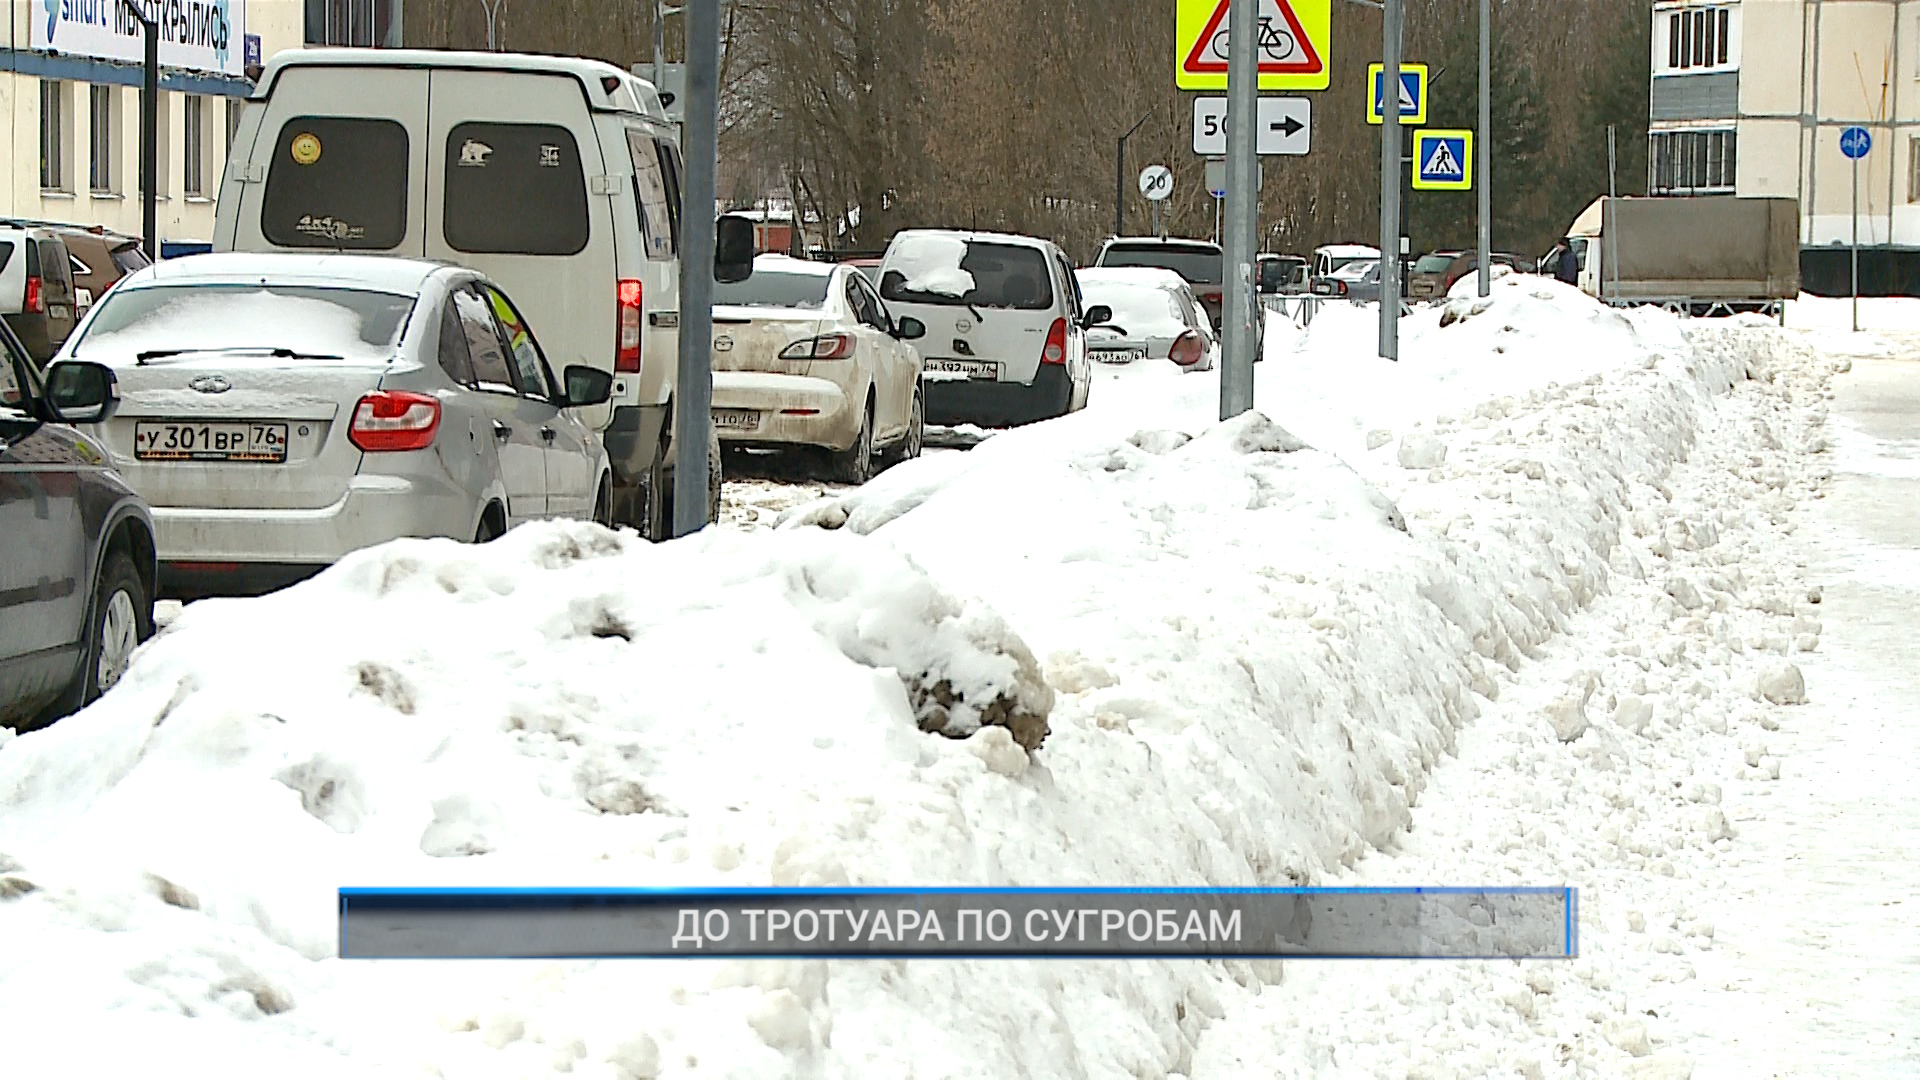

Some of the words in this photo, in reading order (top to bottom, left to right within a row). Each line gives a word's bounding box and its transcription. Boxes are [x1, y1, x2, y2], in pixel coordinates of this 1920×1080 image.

[1204, 115, 1228, 136] 5
[1147, 175, 1166, 190] 20
[253, 427, 277, 444] 76
